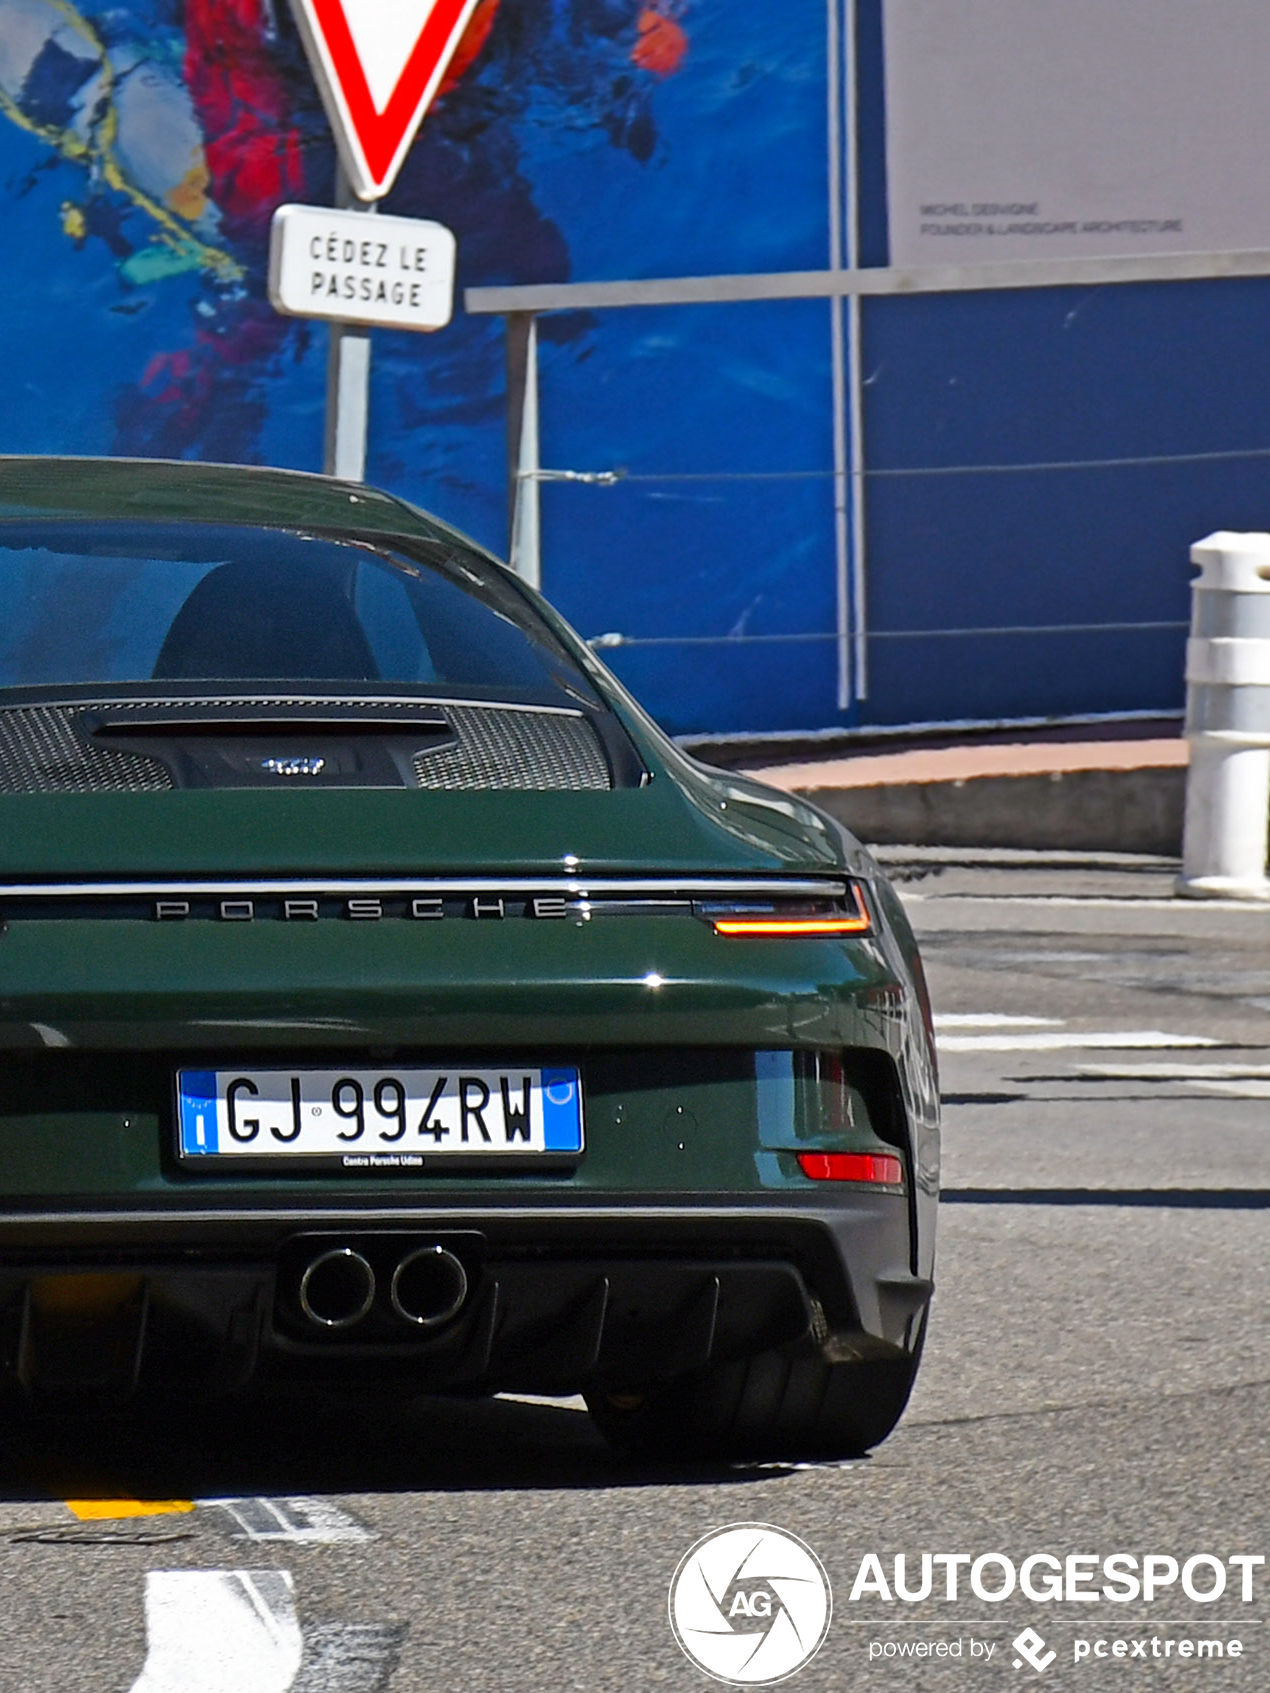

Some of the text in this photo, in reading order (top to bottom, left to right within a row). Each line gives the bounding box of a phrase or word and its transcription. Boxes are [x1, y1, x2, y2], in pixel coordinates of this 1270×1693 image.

[920, 203, 969, 216] MICHEL
[920, 222, 983, 236] FOUNDER
[999, 220, 1077, 235] LANDSCAPE
[310, 231, 427, 272] CÉDEZ LE
[310, 271, 422, 307] PASSAGE
[157, 898, 567, 919] PORSCHE
[226, 1077, 532, 1143] GJ 994RW
